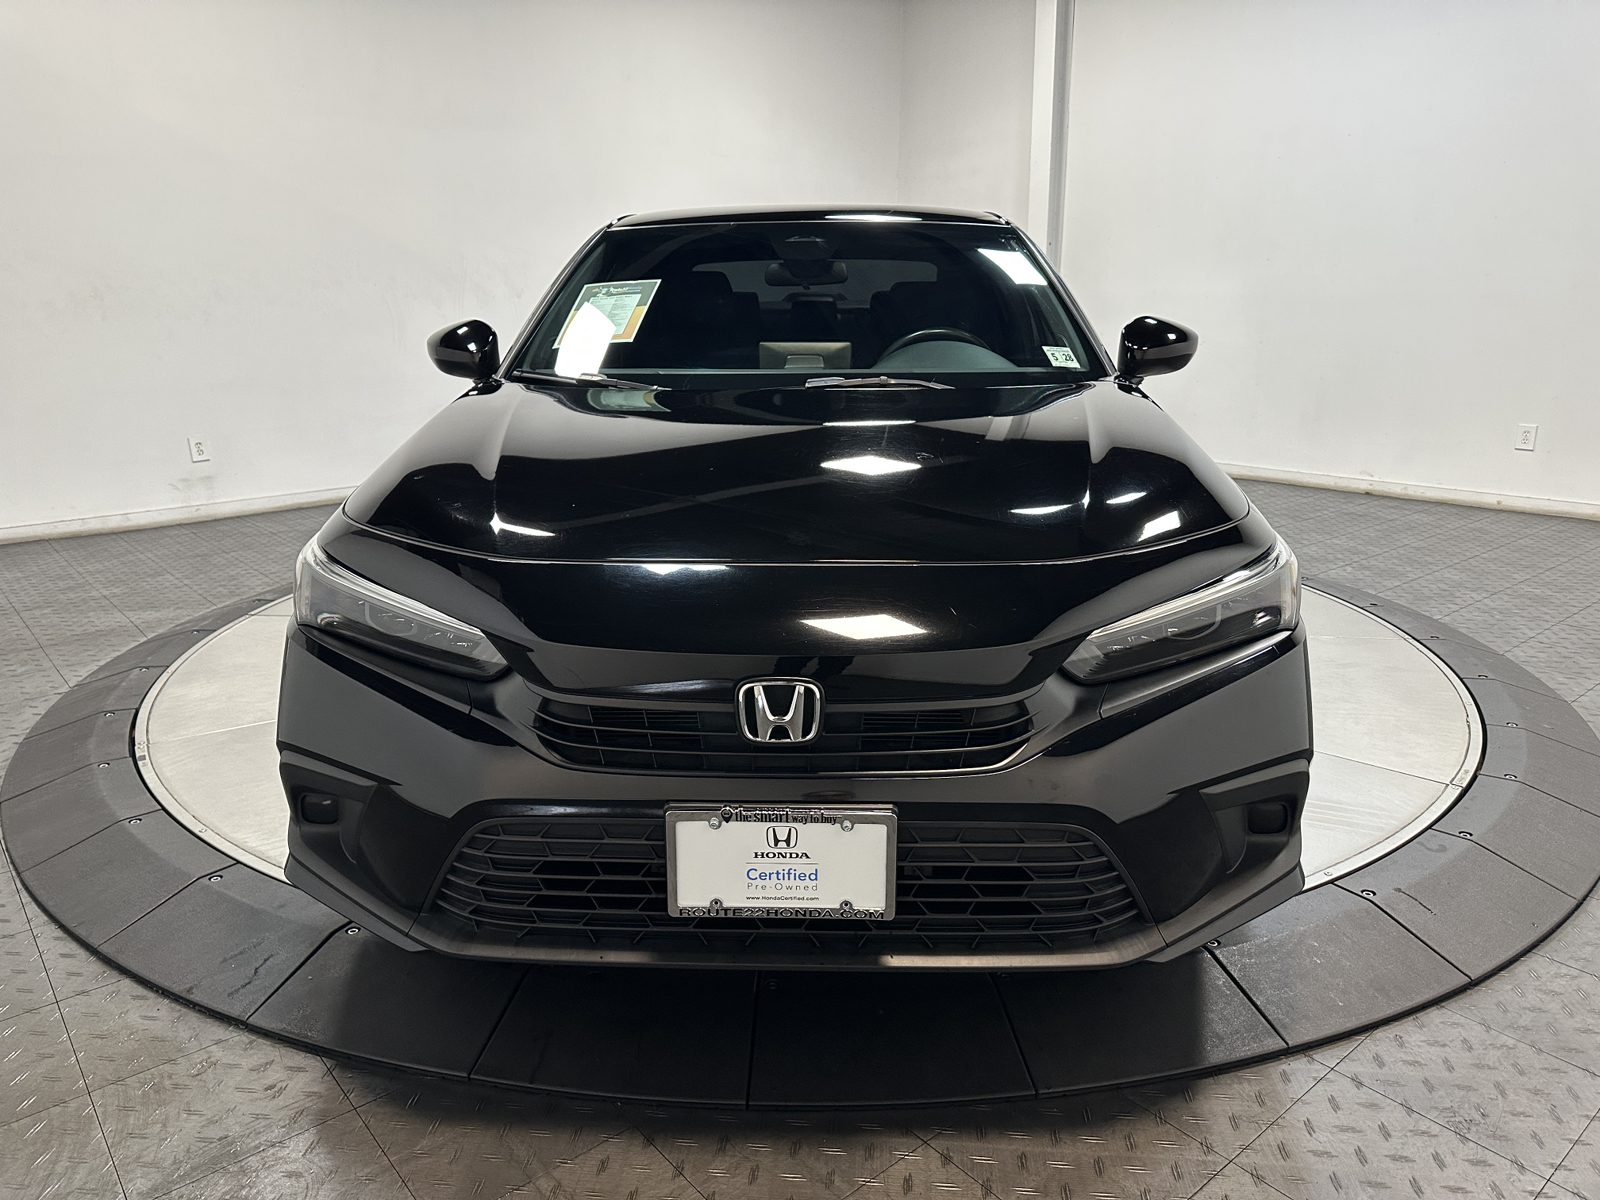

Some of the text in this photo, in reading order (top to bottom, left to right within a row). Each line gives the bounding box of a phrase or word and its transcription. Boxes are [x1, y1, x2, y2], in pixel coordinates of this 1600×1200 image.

[1051, 352, 1074, 362] 5 28
[735, 810, 836, 825] the smart way to buy
[746, 868, 818, 881] Certified
[748, 883, 818, 891] Pre-Owned
